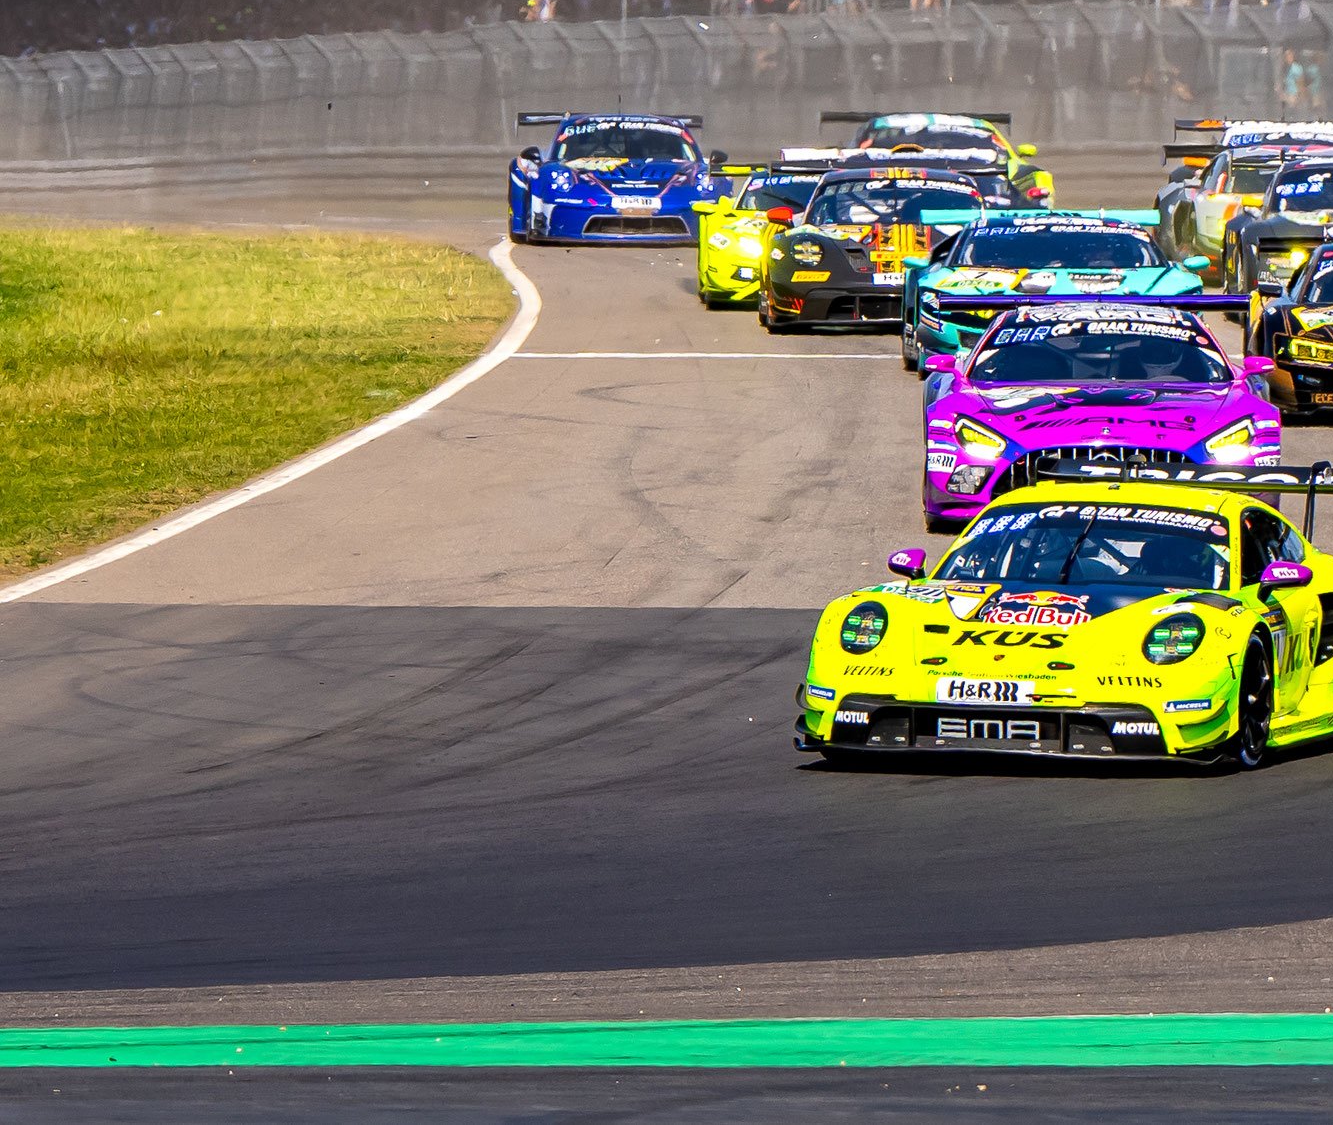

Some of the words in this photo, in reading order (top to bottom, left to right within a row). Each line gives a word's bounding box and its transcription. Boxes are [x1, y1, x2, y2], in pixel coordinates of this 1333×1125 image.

[1088, 322, 1128, 332] GRAN
[1079, 506, 1130, 518] GRAN
[1133, 508, 1213, 527] TURISMO
[984, 605, 1032, 625] Red
[1036, 608, 1091, 626] Bull
[952, 629, 1068, 649] KÜS
[844, 665, 895, 676] VELTINS
[948, 680, 991, 698] H&R
[835, 711, 869, 724] MOTUL
[1111, 722, 1160, 736] MOTUL
